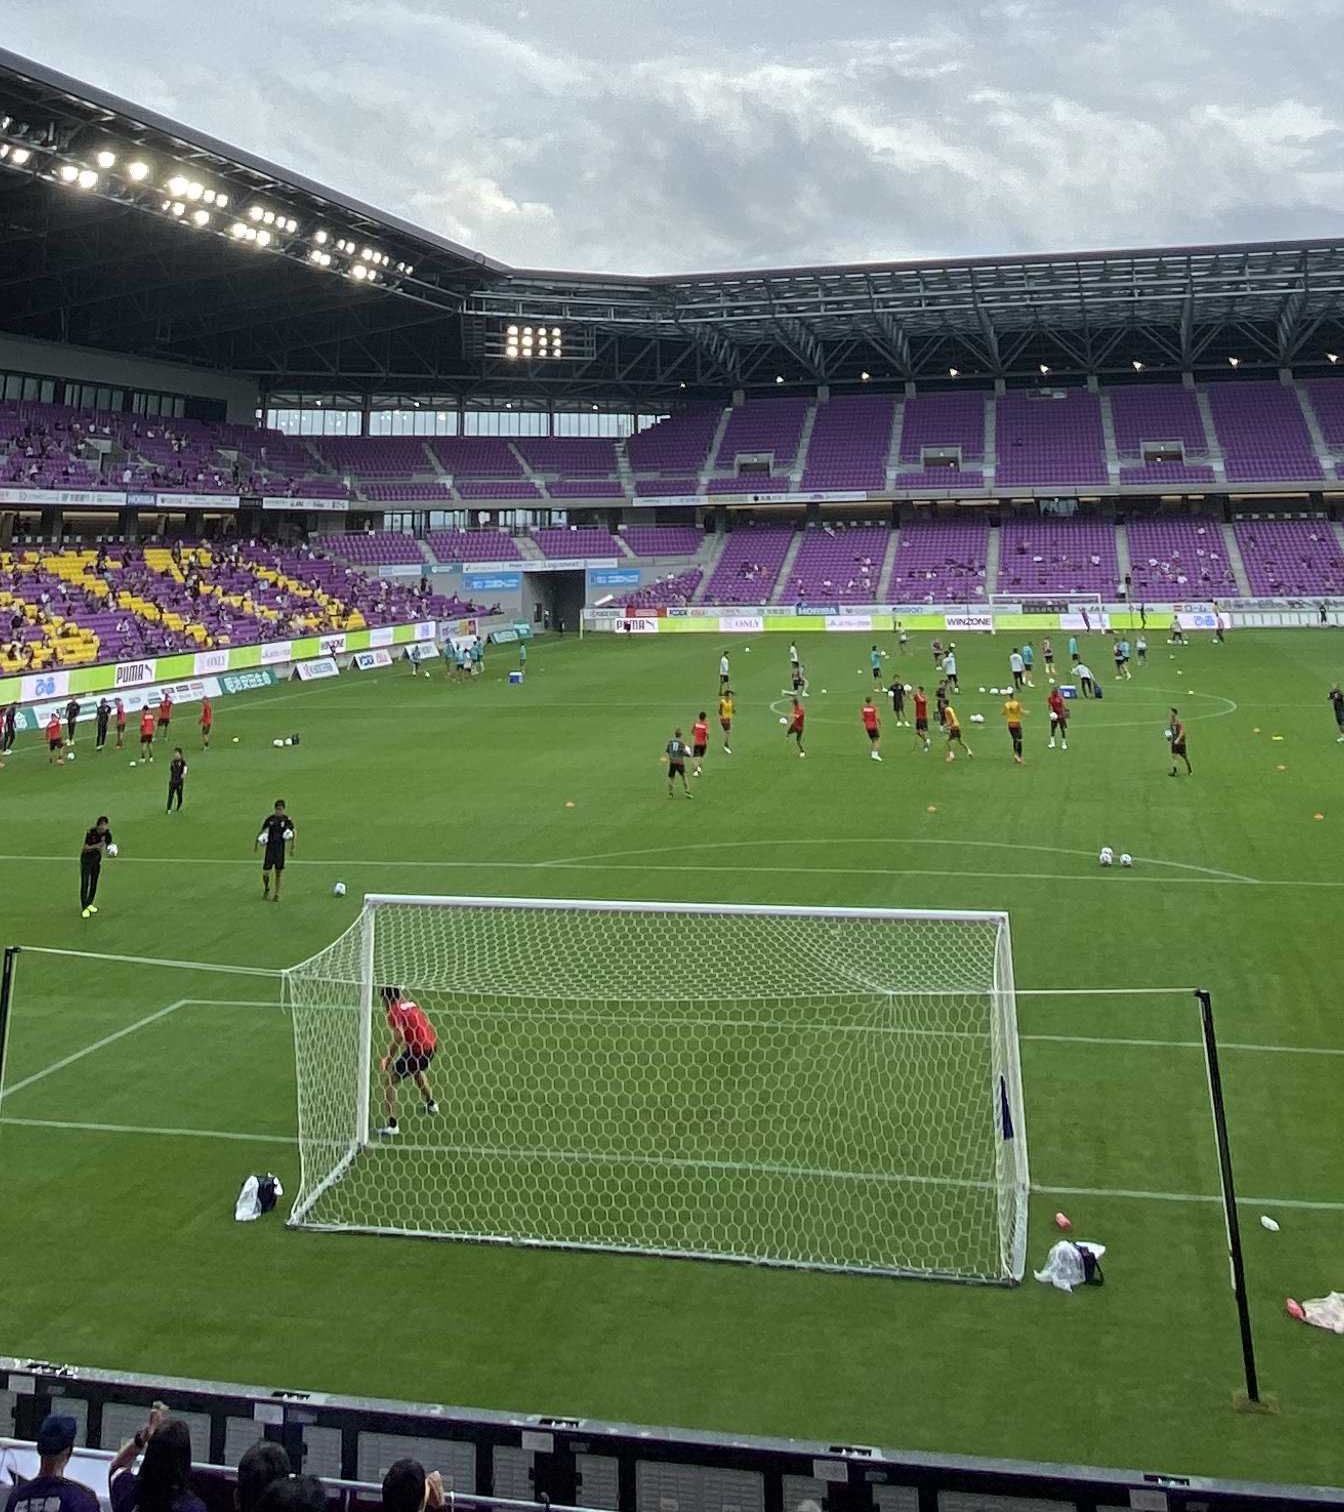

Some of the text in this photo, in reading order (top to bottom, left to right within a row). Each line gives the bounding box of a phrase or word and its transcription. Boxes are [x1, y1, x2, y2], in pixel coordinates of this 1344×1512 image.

[616, 620, 645, 631] PMA
[947, 617, 991, 627] WINZONE
[116, 664, 144, 681] PUMA
